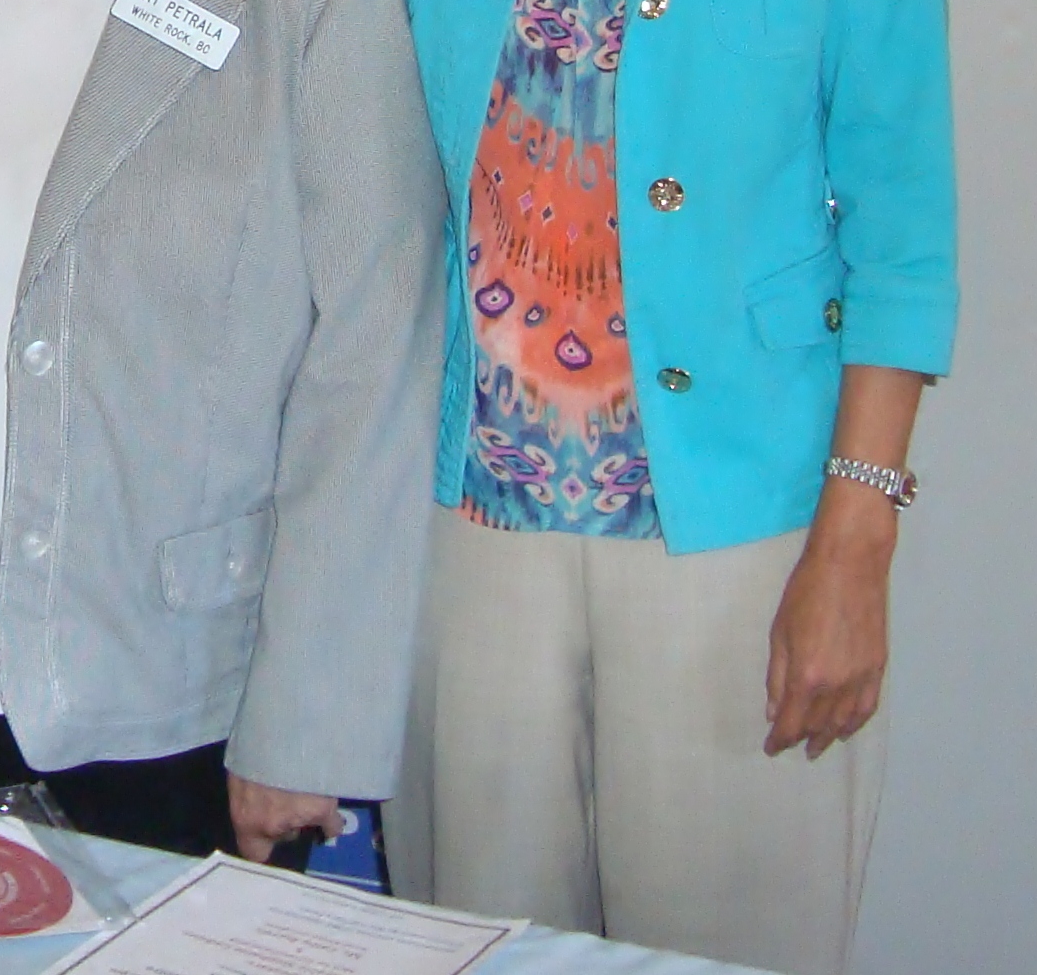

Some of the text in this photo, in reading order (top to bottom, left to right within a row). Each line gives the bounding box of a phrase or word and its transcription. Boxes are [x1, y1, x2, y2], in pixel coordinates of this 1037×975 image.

[131, 4, 162, 28] WHITE
[195, 40, 211, 55] BC
[166, 1, 223, 41] PETRALA
